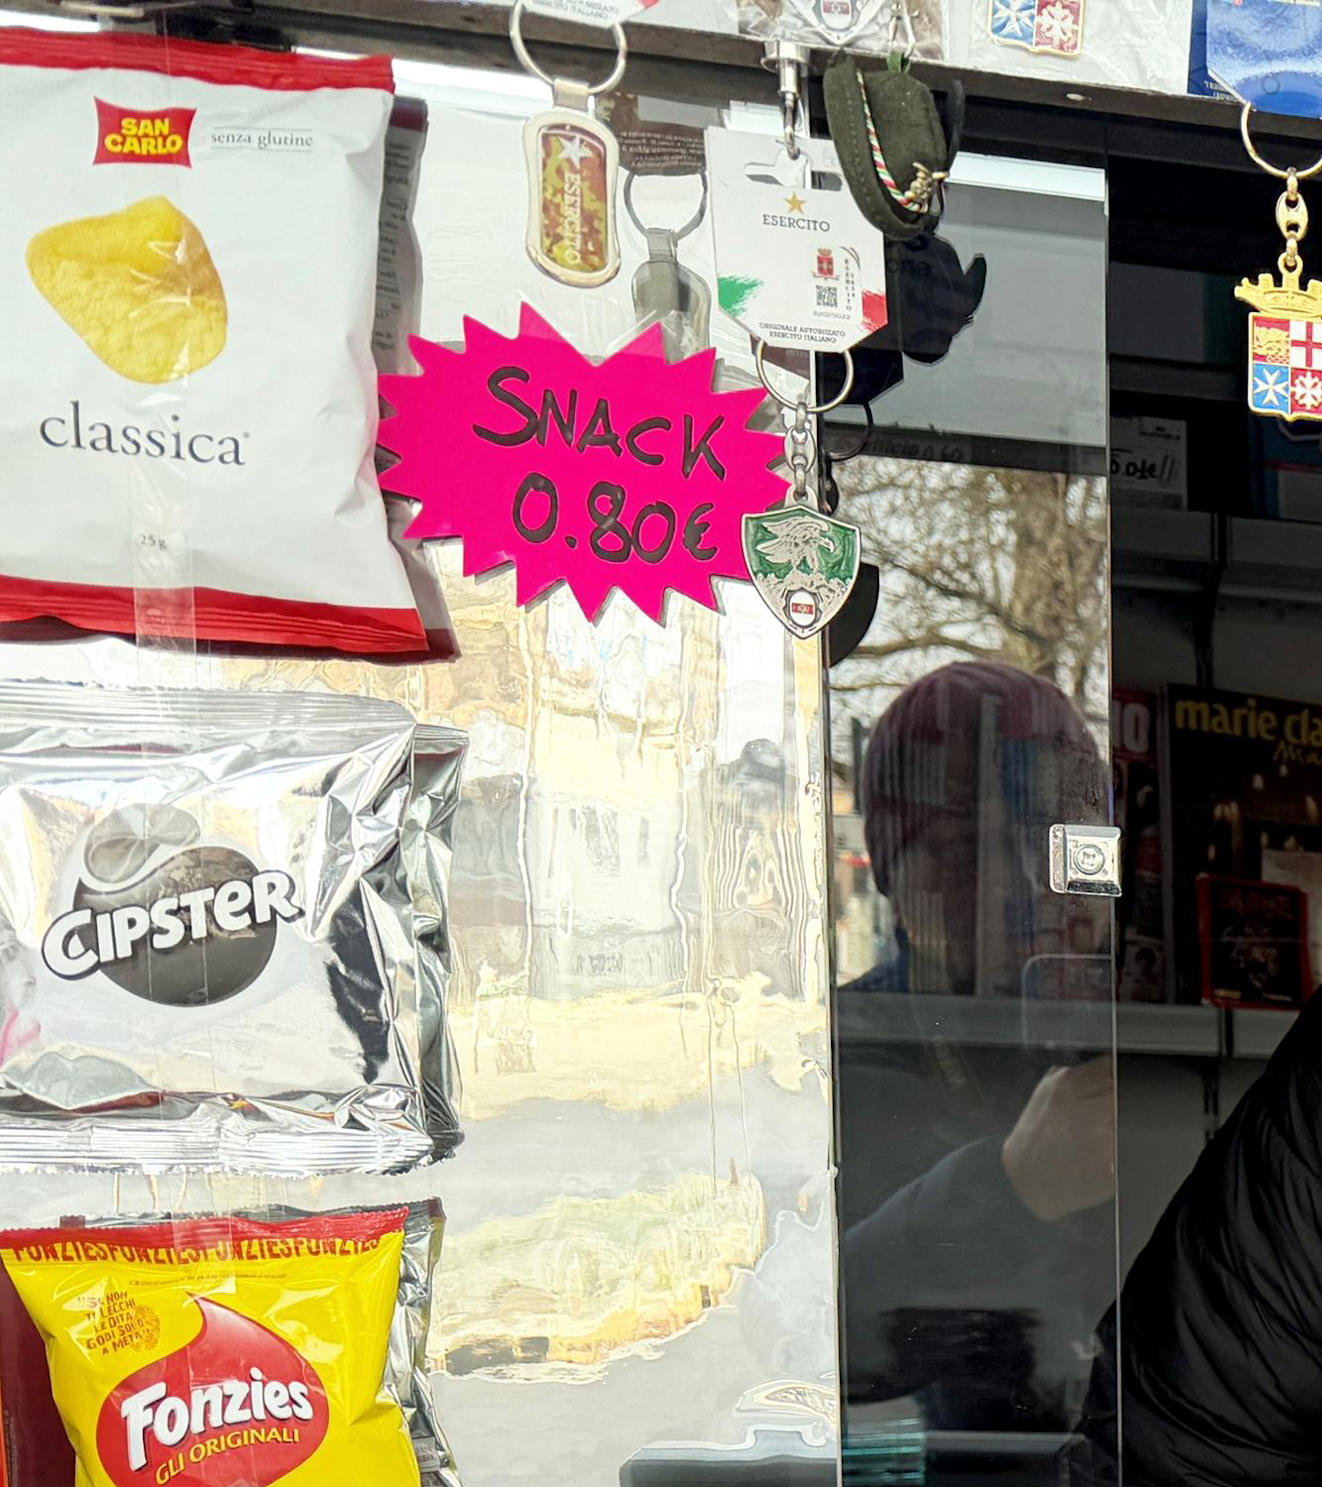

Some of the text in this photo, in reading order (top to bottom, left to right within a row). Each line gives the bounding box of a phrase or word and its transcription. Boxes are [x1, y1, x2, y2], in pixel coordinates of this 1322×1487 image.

[103, 131, 183, 155] CARLO
[121, 117, 170, 137] SAN
[210, 129, 313, 150] senza glutine
[565, 173, 580, 264] ESERCITO
[762, 214, 830, 232] ESERCITO
[40, 402, 243, 467] classica
[473, 368, 726, 482] SNACK
[512, 474, 719, 564] 0.80€
[1173, 699, 1278, 743] marie
[122, 1367, 313, 1472] Fonzies
[155, 1427, 300, 1486] GLI ORIGINALI
